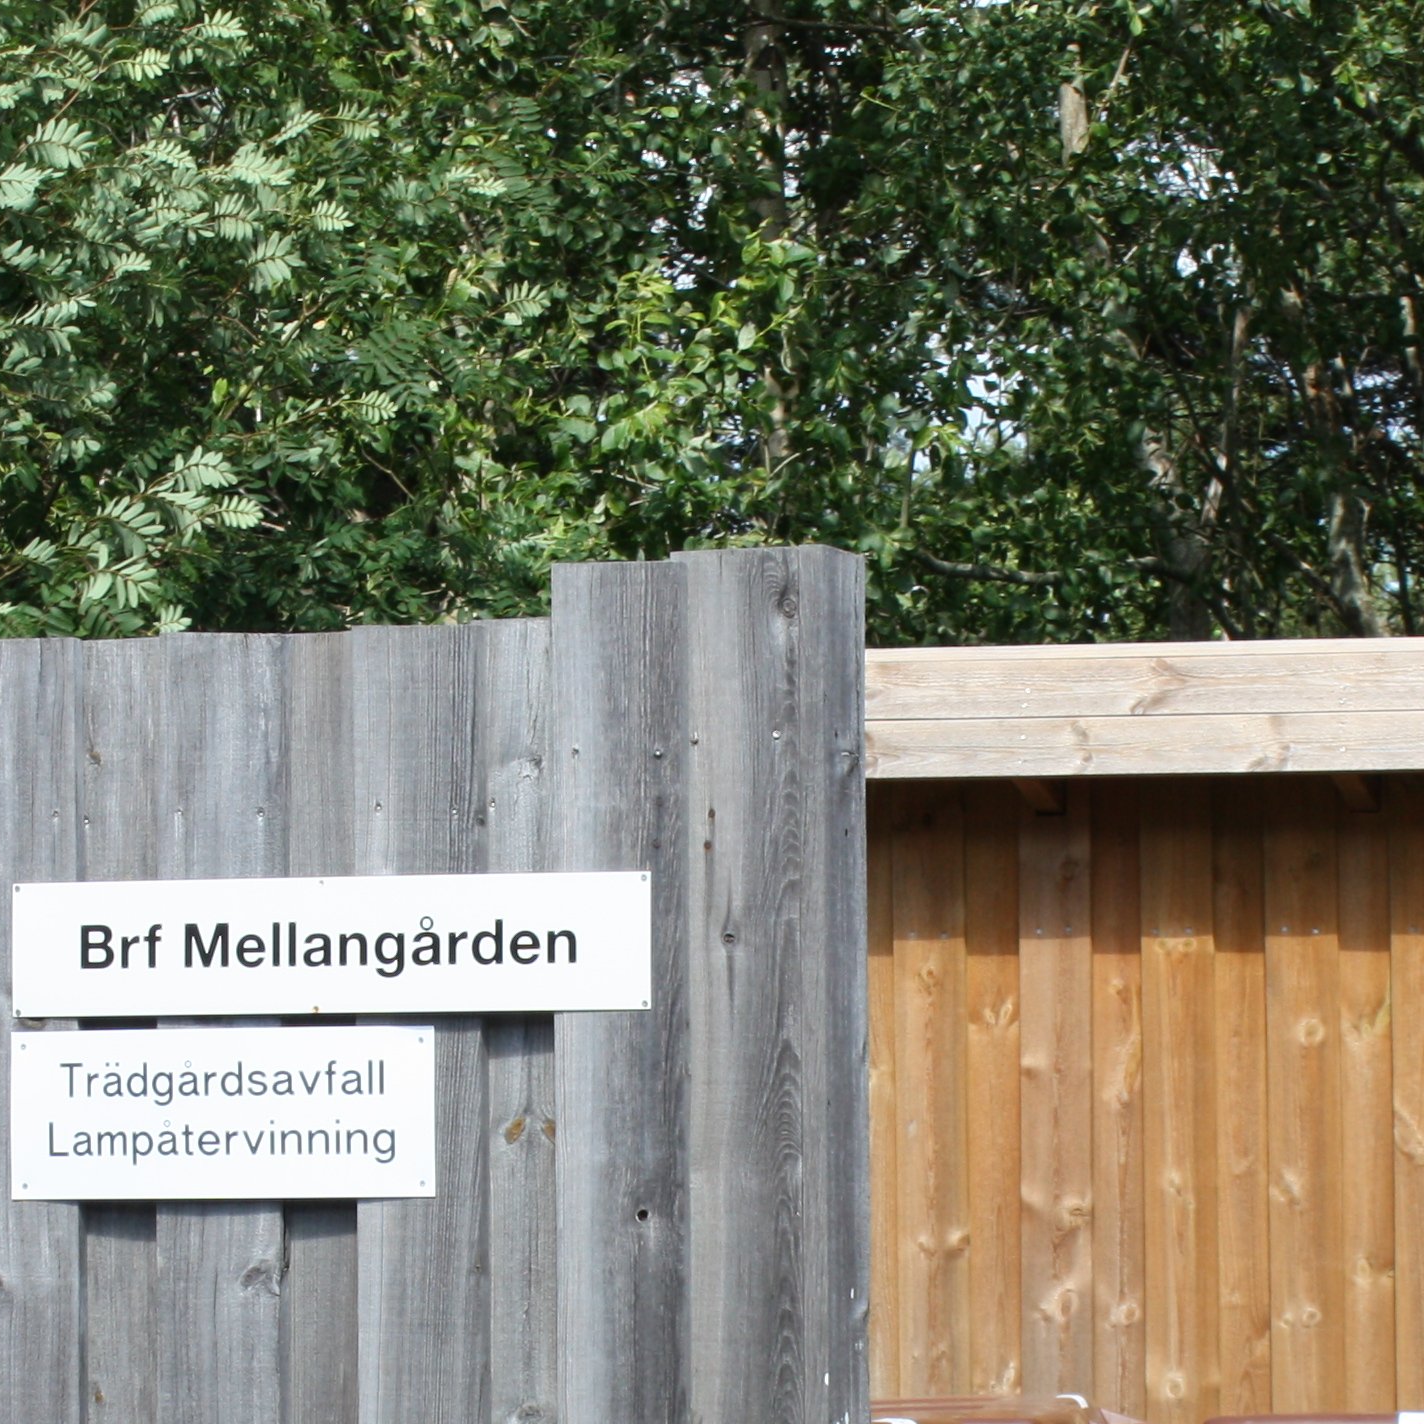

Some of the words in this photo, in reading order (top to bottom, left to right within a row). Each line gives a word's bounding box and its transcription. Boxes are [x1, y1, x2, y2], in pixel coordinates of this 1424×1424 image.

[80, 923, 163, 970] Brf
[184, 915, 577, 978] Mellangården
[59, 1059, 385, 1106] Trädgårdsavfall
[48, 1119, 396, 1165] Lampåtervinning
